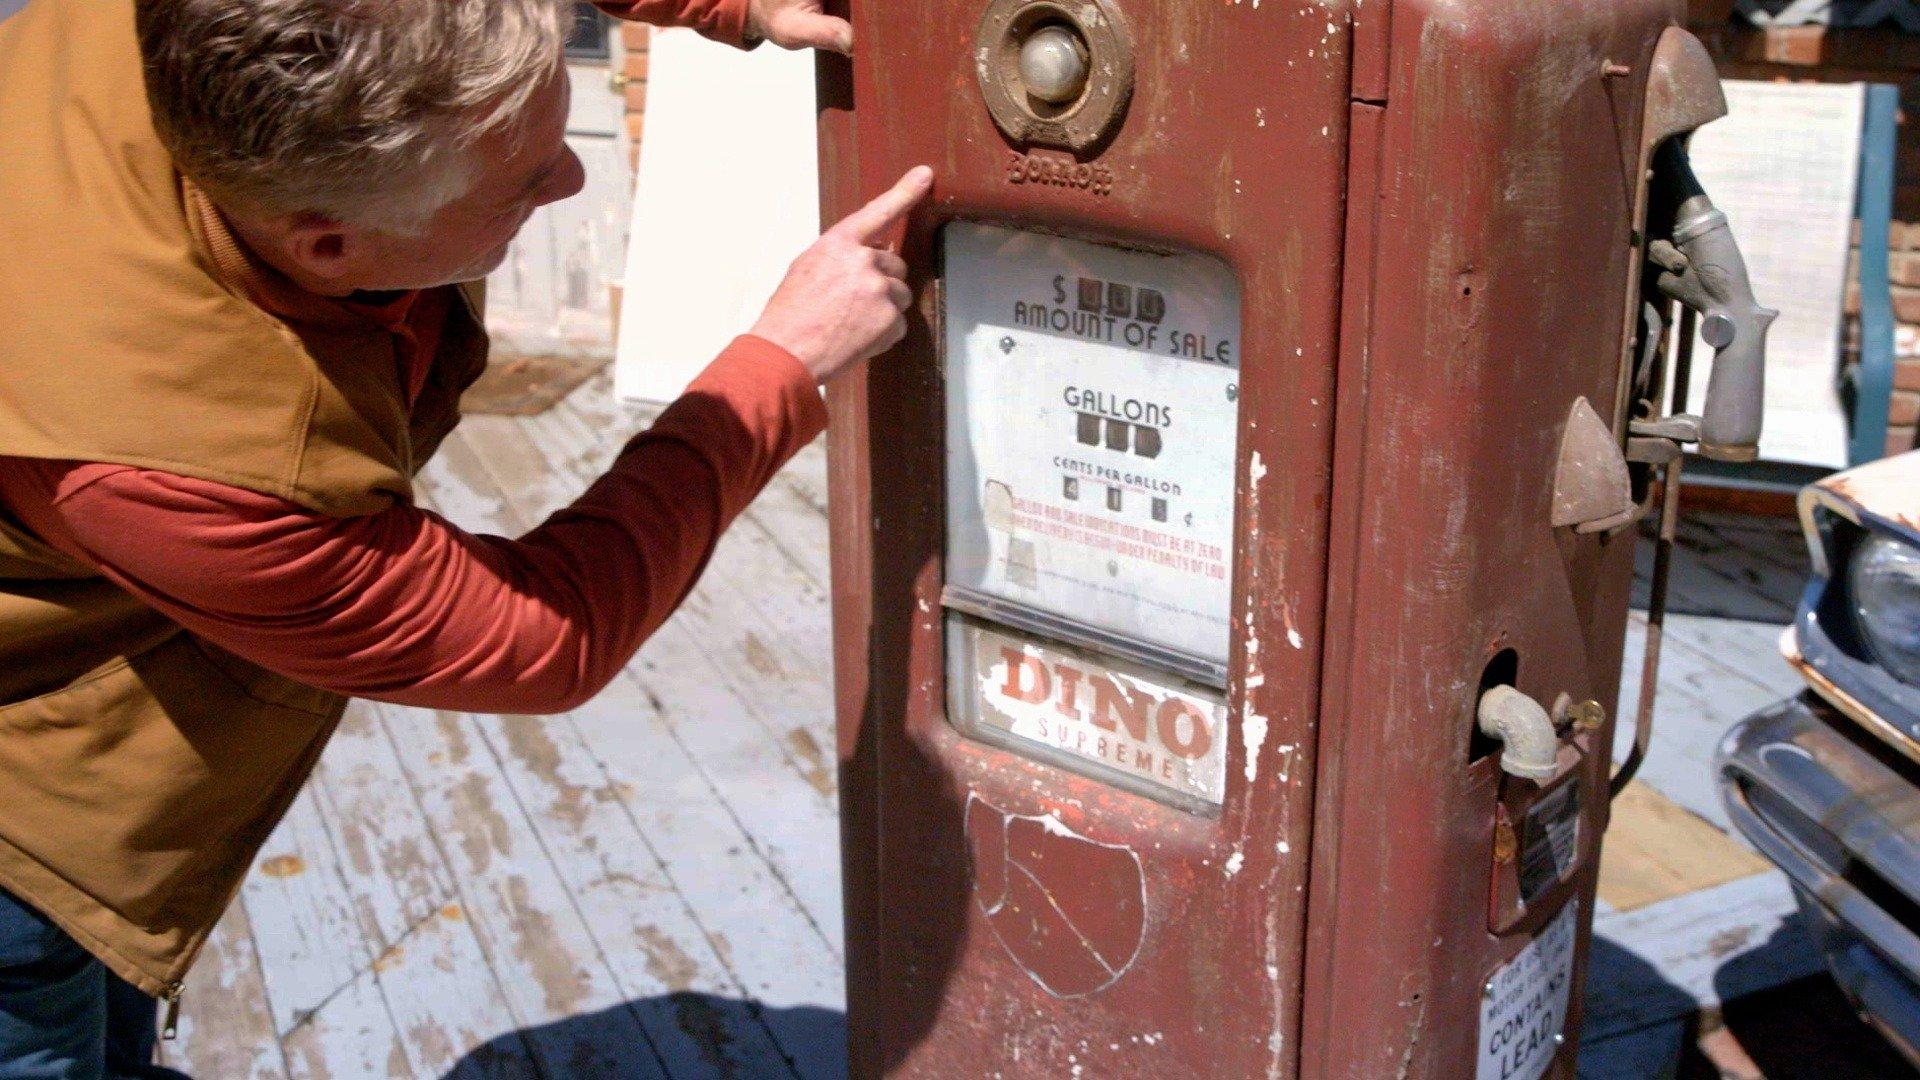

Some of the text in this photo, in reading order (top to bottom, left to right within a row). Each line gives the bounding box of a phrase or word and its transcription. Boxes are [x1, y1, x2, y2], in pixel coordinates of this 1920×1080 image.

[1014, 300, 1116, 342] AMOUNT
[1124, 322, 1158, 349] OF
[1170, 330, 1230, 364] SALE
[1063, 385, 1172, 427] GALLONS
[1053, 455, 1092, 475] CENTS
[1097, 465, 1120, 481] PER
[1125, 472, 1181, 496] GALLON
[1142, 529, 1167, 548] MUST
[1169, 536, 1181, 551] BE
[1183, 540, 1196, 554] AT
[1198, 543, 1223, 561] ZERO
[1191, 559, 1203, 573] OF
[1205, 562, 1225, 580] LAW
[1000, 646, 1212, 760] DINO
[1037, 716, 1174, 779] SUPREME
[1490, 965, 1566, 1055] CONTAINS
[1501, 1010, 1552, 1080] LEAD
